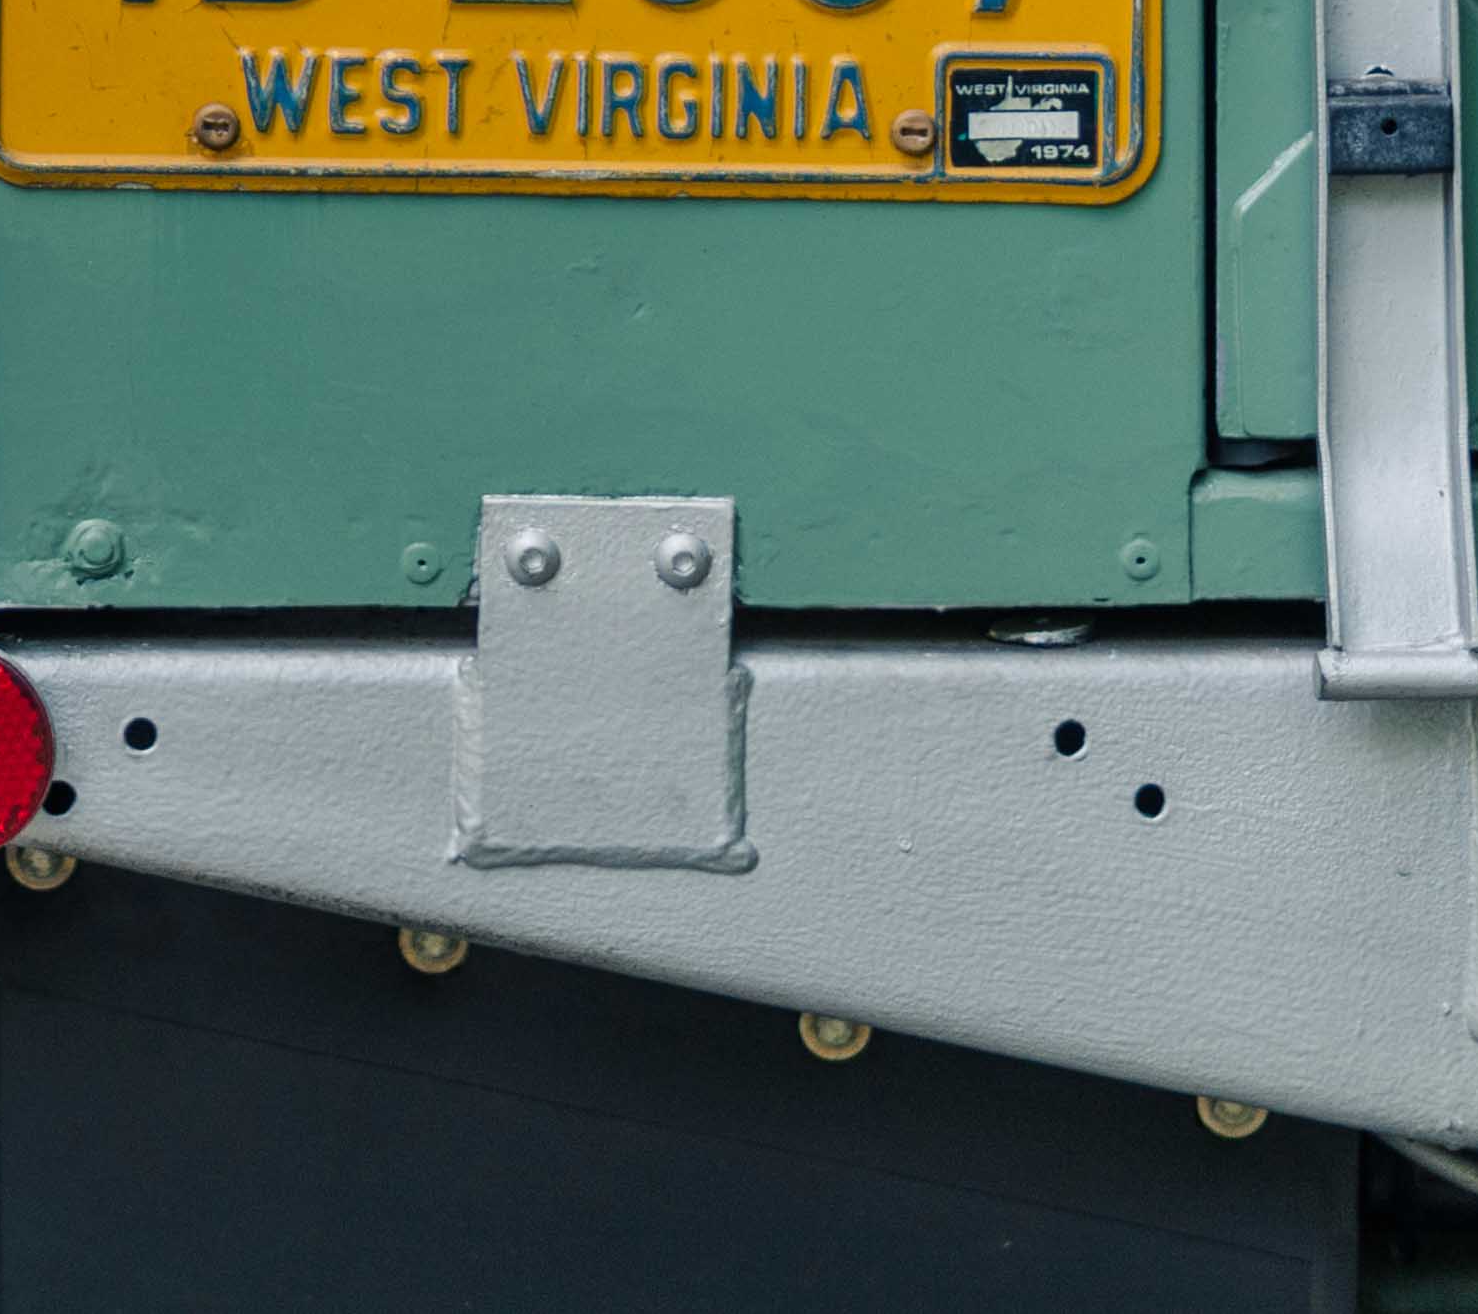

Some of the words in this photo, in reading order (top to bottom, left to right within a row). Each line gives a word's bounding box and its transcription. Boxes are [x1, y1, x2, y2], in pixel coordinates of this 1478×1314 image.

[237, 50, 472, 137] WEST
[512, 55, 876, 143] VIRGINIA
[955, 83, 1005, 96] WEST
[1013, 83, 1091, 95] VIRGINIA
[1030, 144, 1091, 160] 1974
